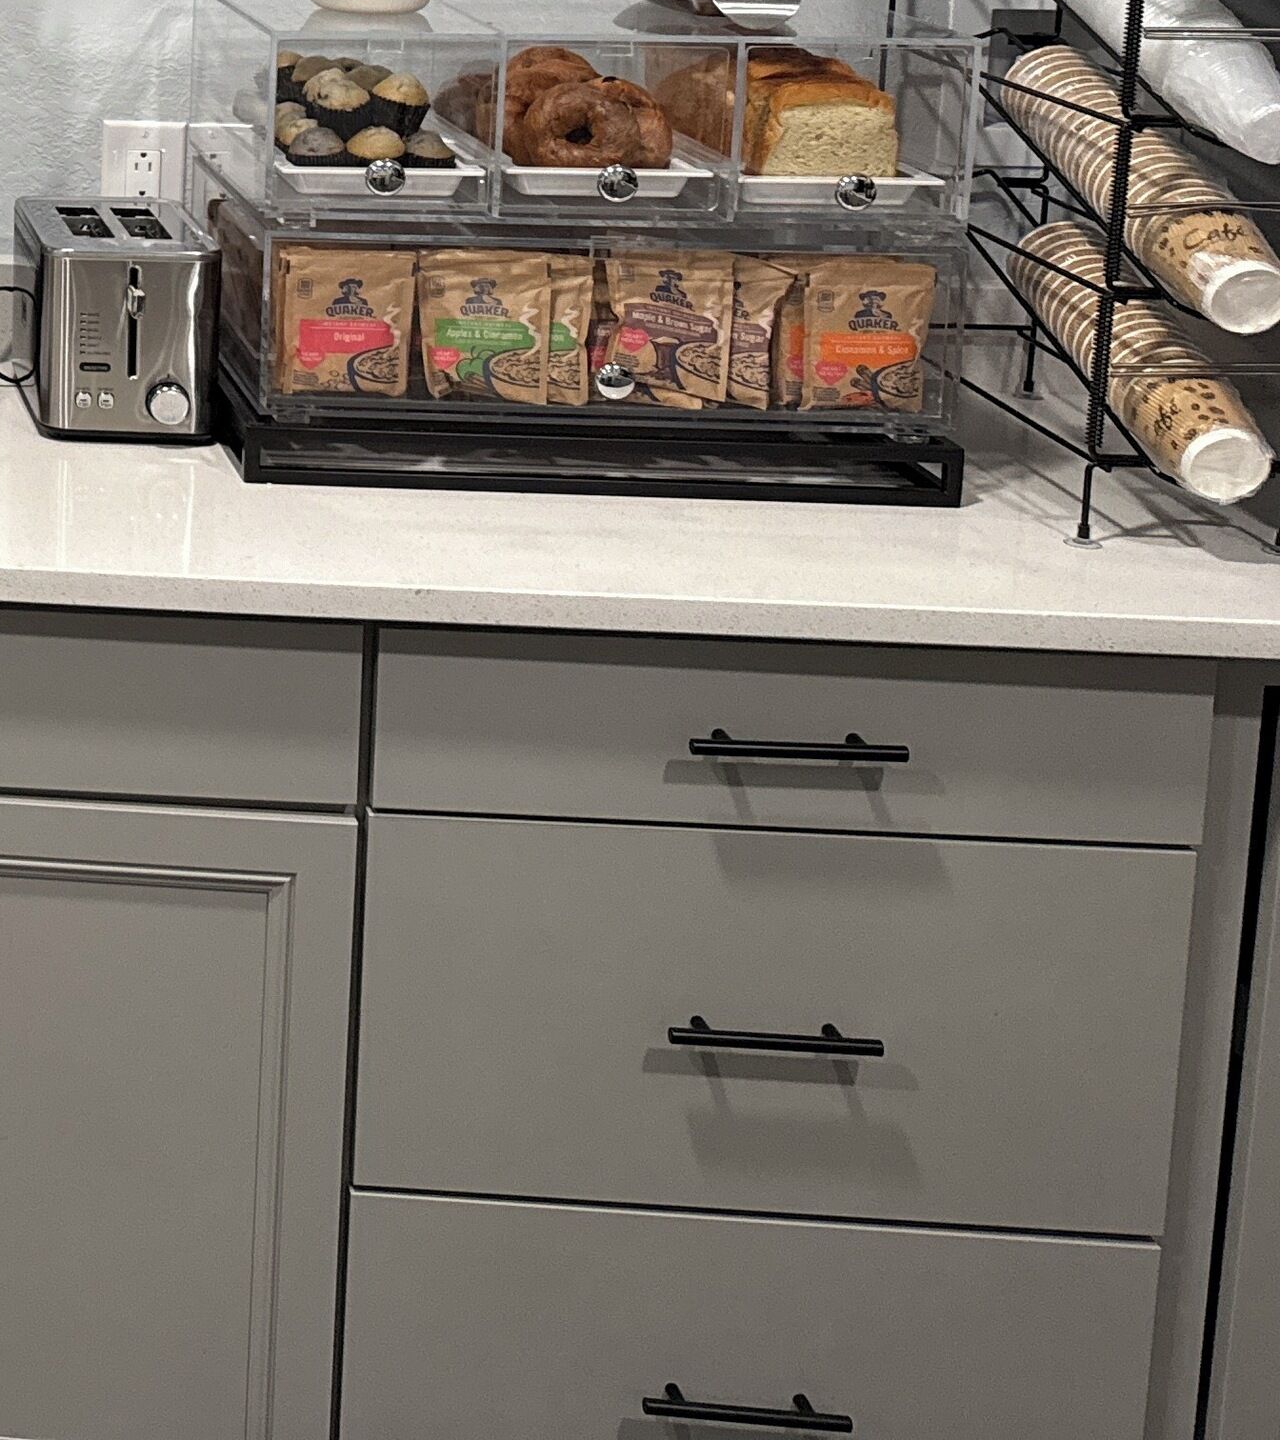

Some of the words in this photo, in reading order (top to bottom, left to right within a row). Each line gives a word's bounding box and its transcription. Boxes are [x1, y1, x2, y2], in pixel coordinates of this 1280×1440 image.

[649, 292, 693, 310] QUAKER
[326, 305, 375, 318] QUAKER
[460, 304, 509, 317] QUAKER
[848, 318, 899, 332] QUAKER
[333, 332, 365, 343] Original
